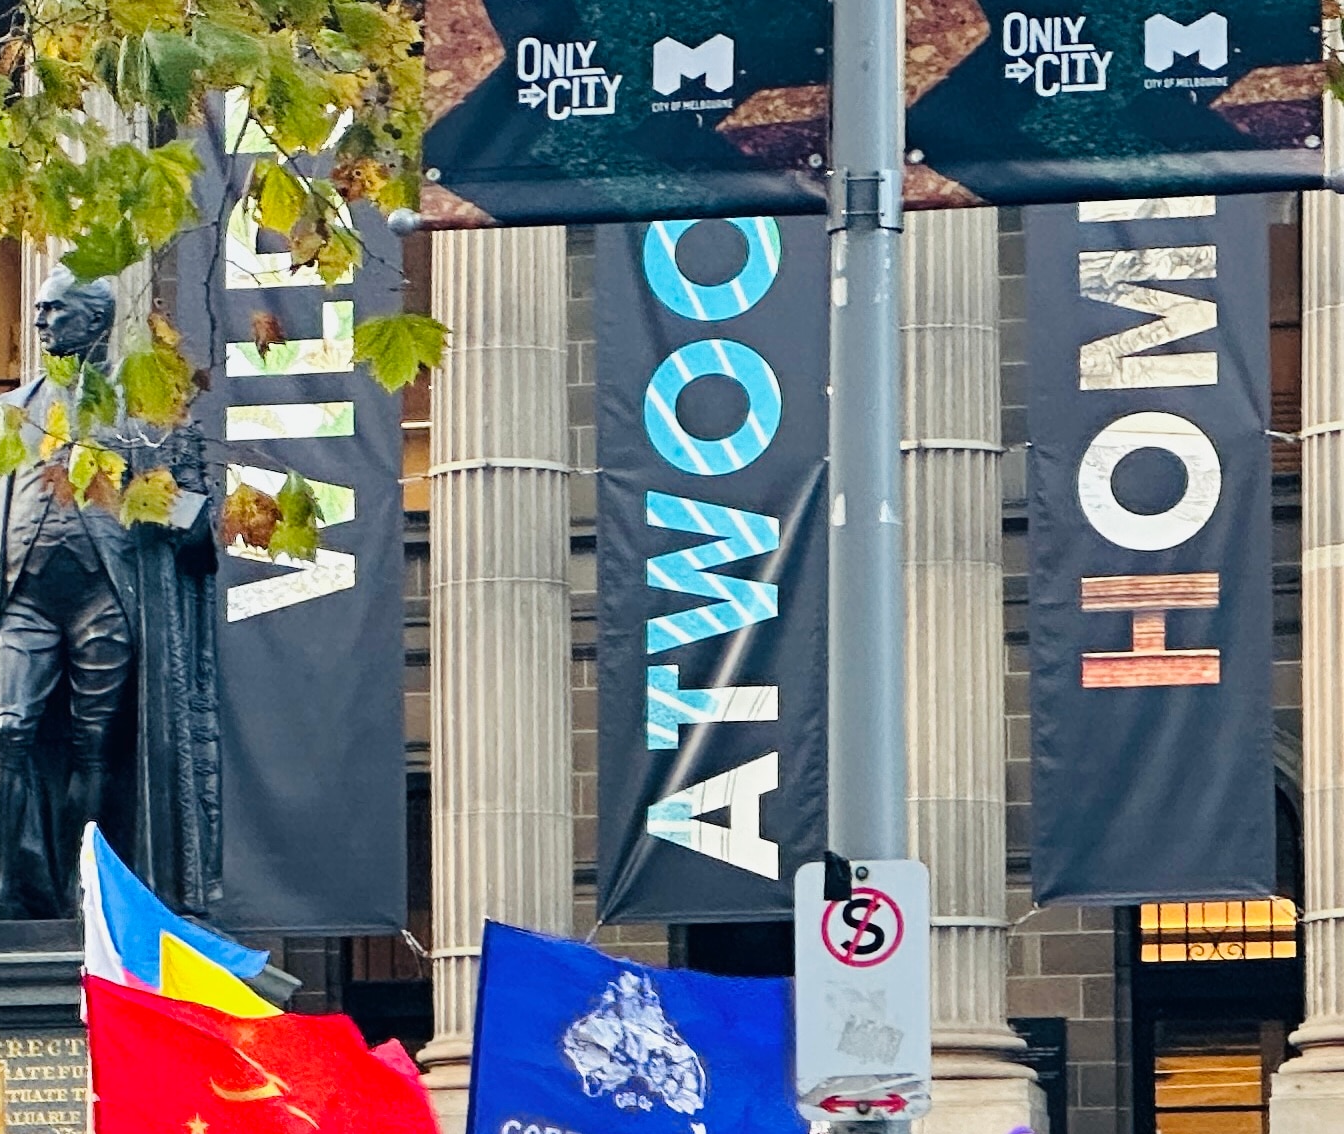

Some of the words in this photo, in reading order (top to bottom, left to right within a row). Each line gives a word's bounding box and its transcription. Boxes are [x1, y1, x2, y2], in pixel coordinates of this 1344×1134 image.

[1003, 12, 1096, 57] ONLY
[517, 37, 606, 82] ONLY
[1034, 51, 1113, 97] CITY
[547, 74, 623, 120] CITY
